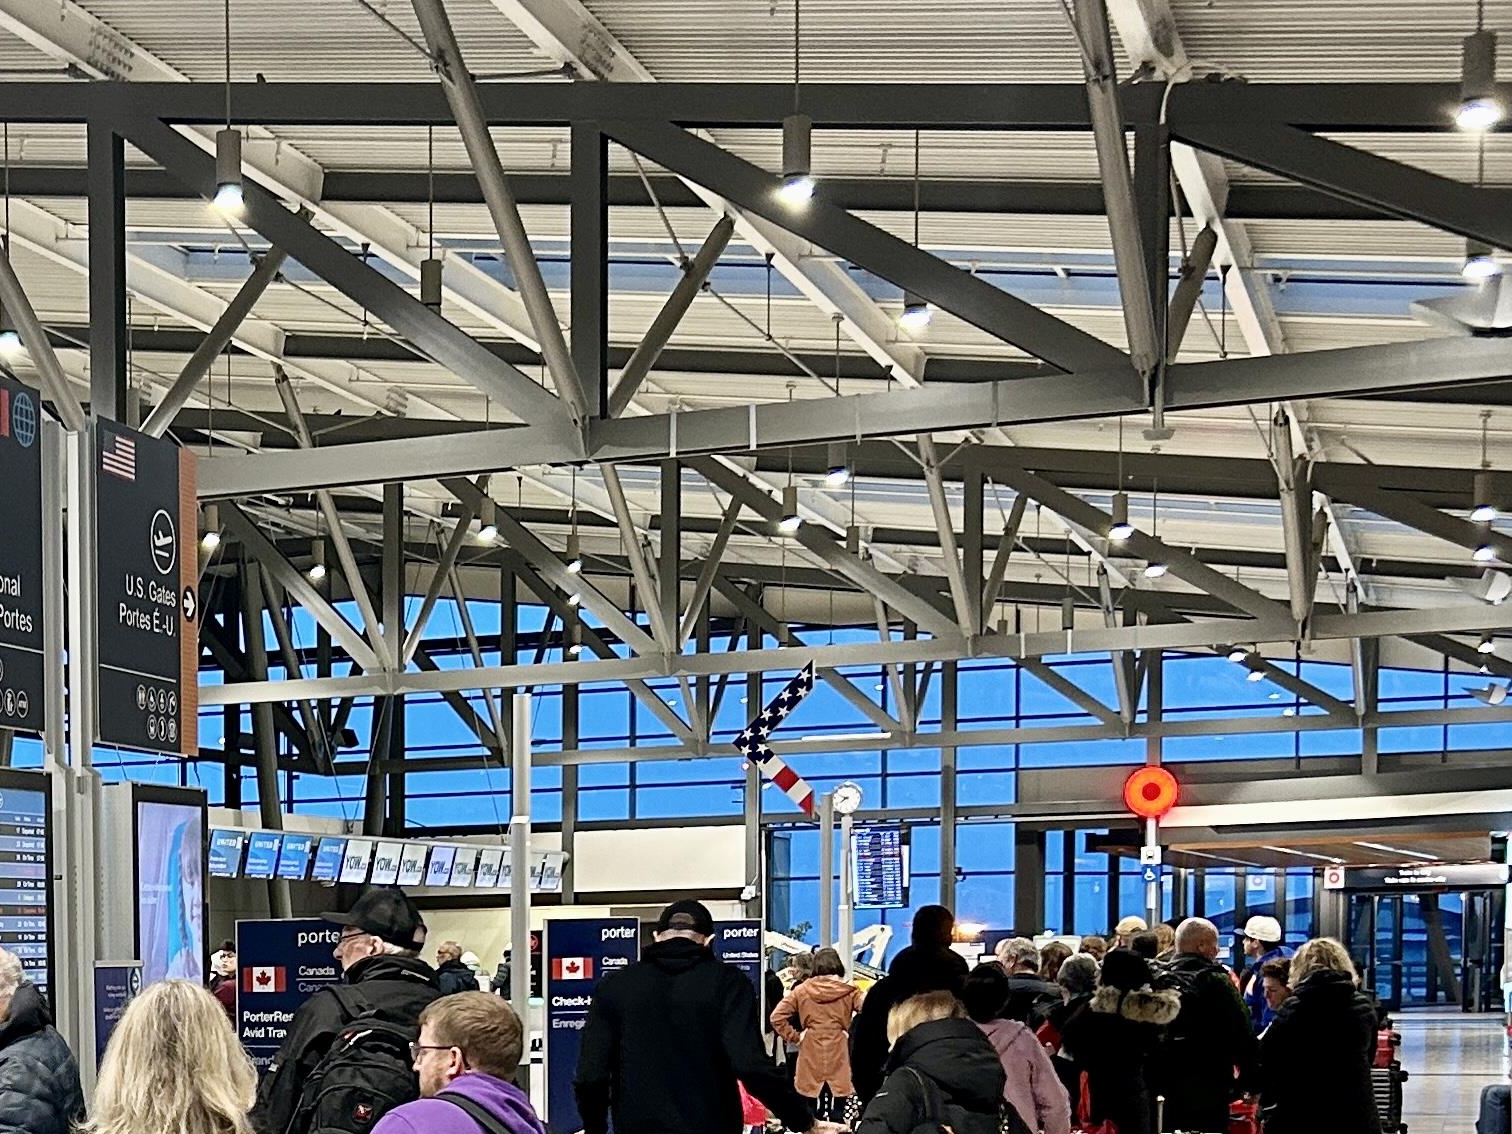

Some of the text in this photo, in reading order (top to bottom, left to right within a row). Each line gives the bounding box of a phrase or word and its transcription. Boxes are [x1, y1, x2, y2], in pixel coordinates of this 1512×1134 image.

[125, 573, 177, 607] U.S. Gates
[119, 602, 151, 631] Portes
[297, 929, 341, 947] porte
[601, 926, 636, 941] porter
[723, 927, 759, 940] porter
[298, 965, 336, 976] Canada
[243, 1026, 265, 1039] Avid
